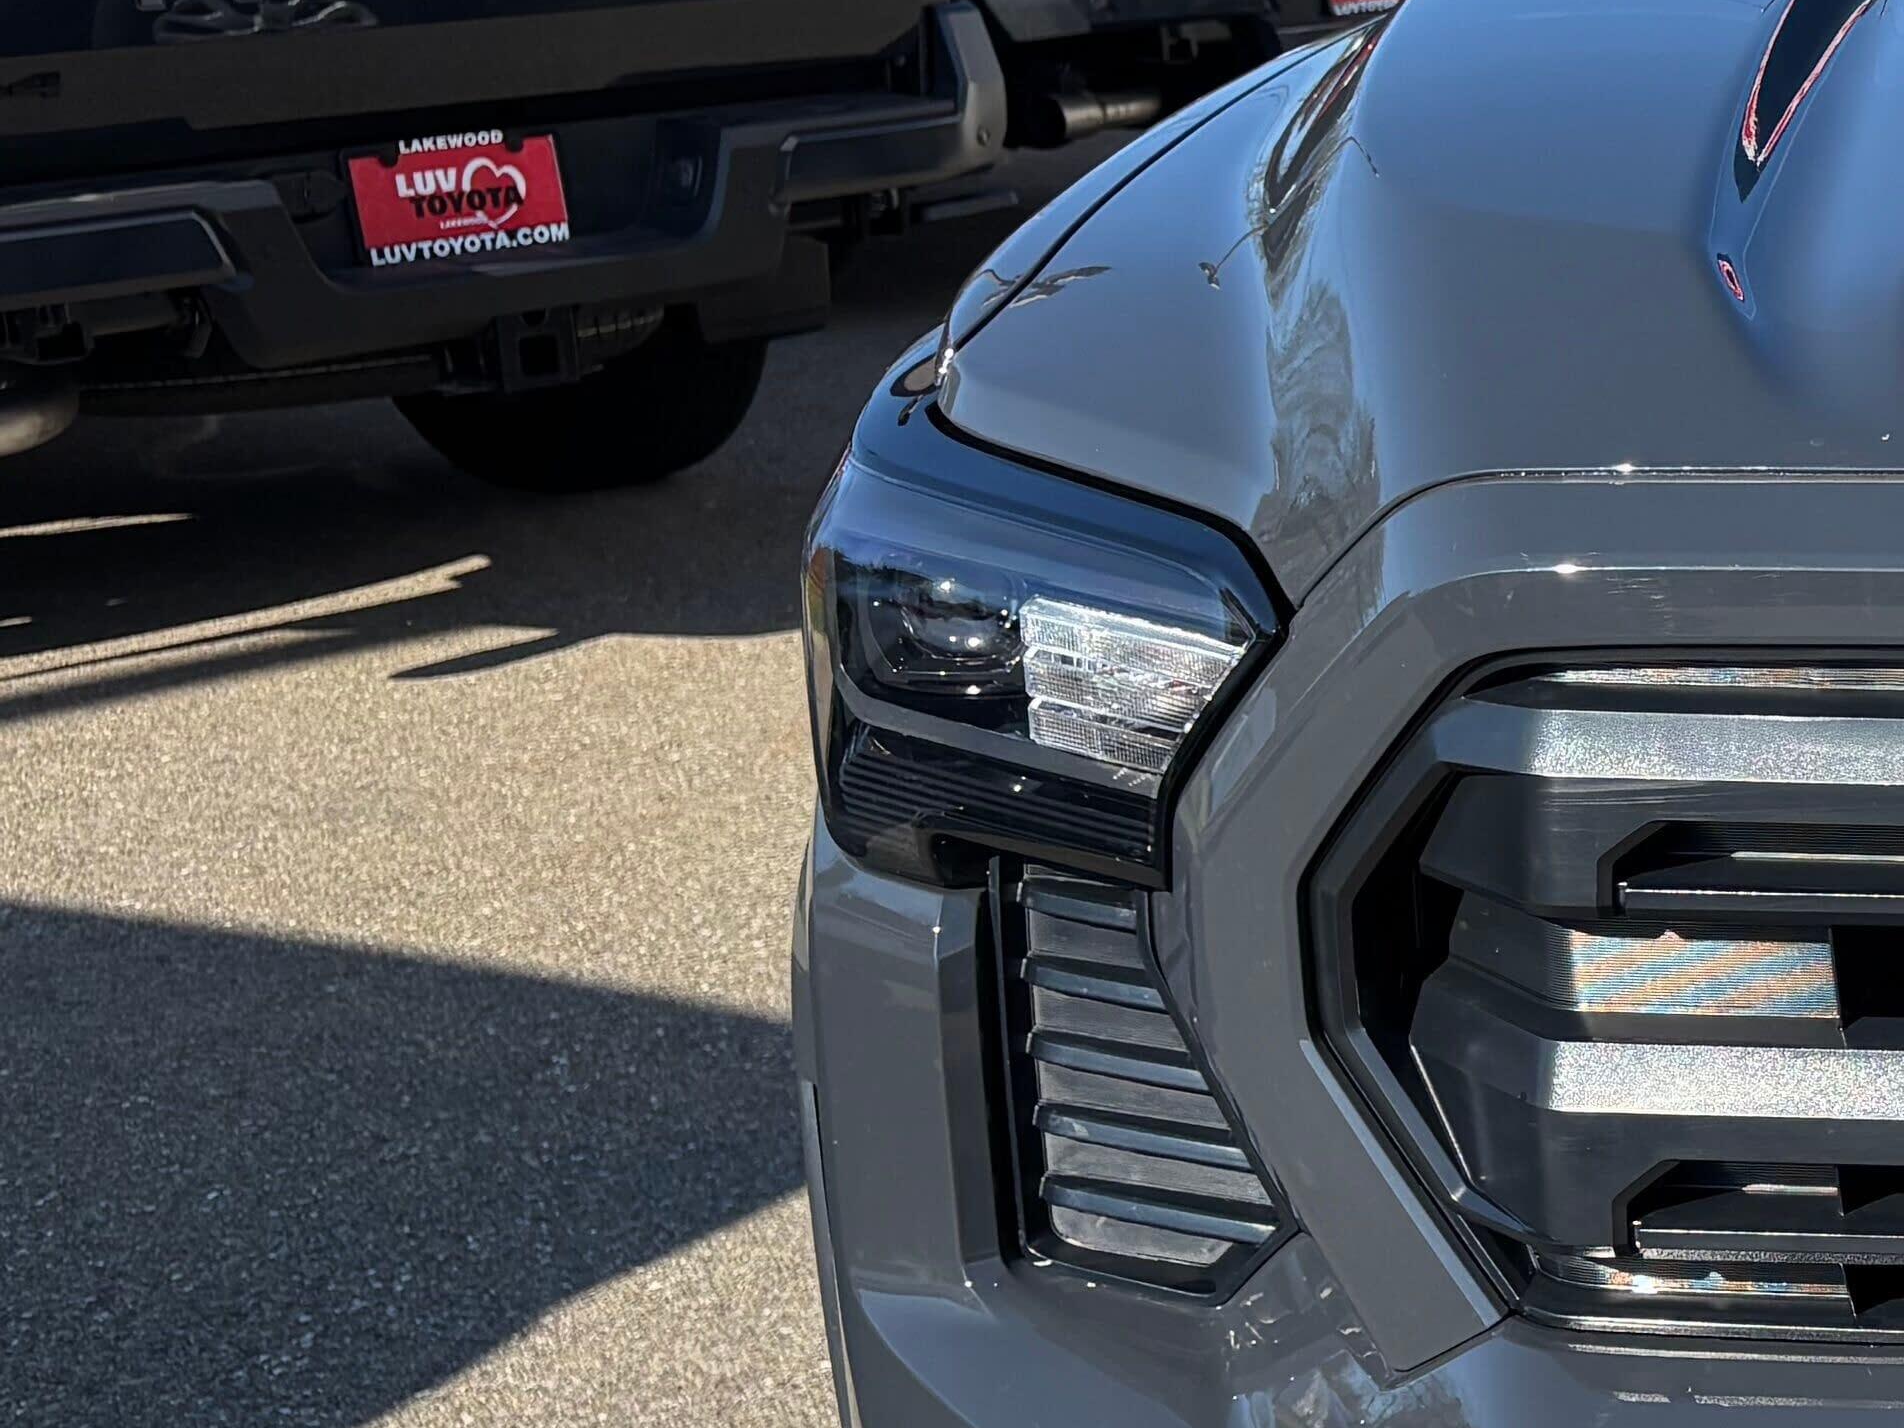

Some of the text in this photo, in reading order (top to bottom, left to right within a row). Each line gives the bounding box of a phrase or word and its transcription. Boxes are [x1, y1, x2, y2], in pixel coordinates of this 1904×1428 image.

[398, 129, 504, 155] LAKEWOOD
[395, 167, 457, 198] LUV
[409, 185, 525, 219] TOYOTA
[370, 222, 570, 267] LUVTOYOTA.COM
